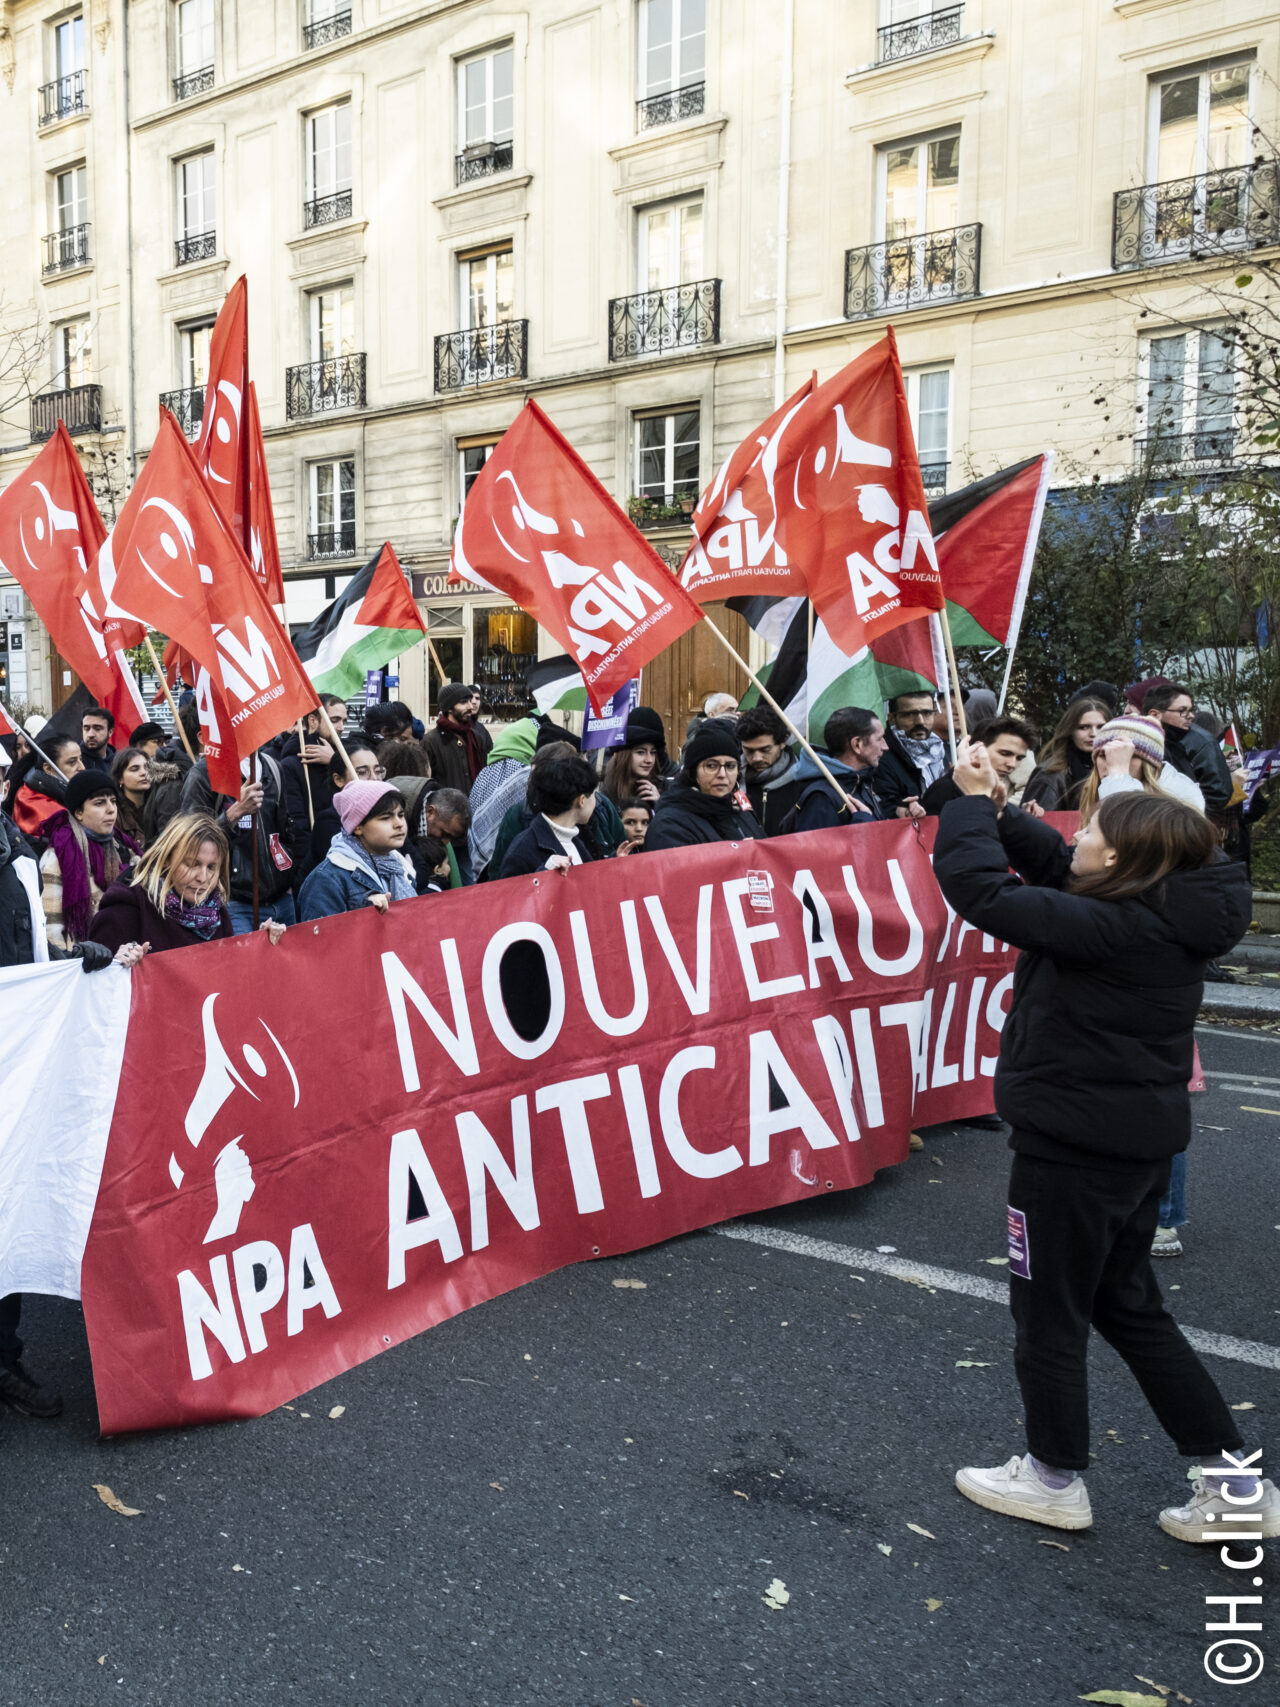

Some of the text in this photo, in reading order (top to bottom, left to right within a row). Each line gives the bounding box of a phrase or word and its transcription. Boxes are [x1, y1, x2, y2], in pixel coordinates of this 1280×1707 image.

[380, 858, 922, 1093] NOUVEAU
[387, 971, 1015, 1291] ANTICAPITALIS
[177, 1223, 342, 1381] NPA
